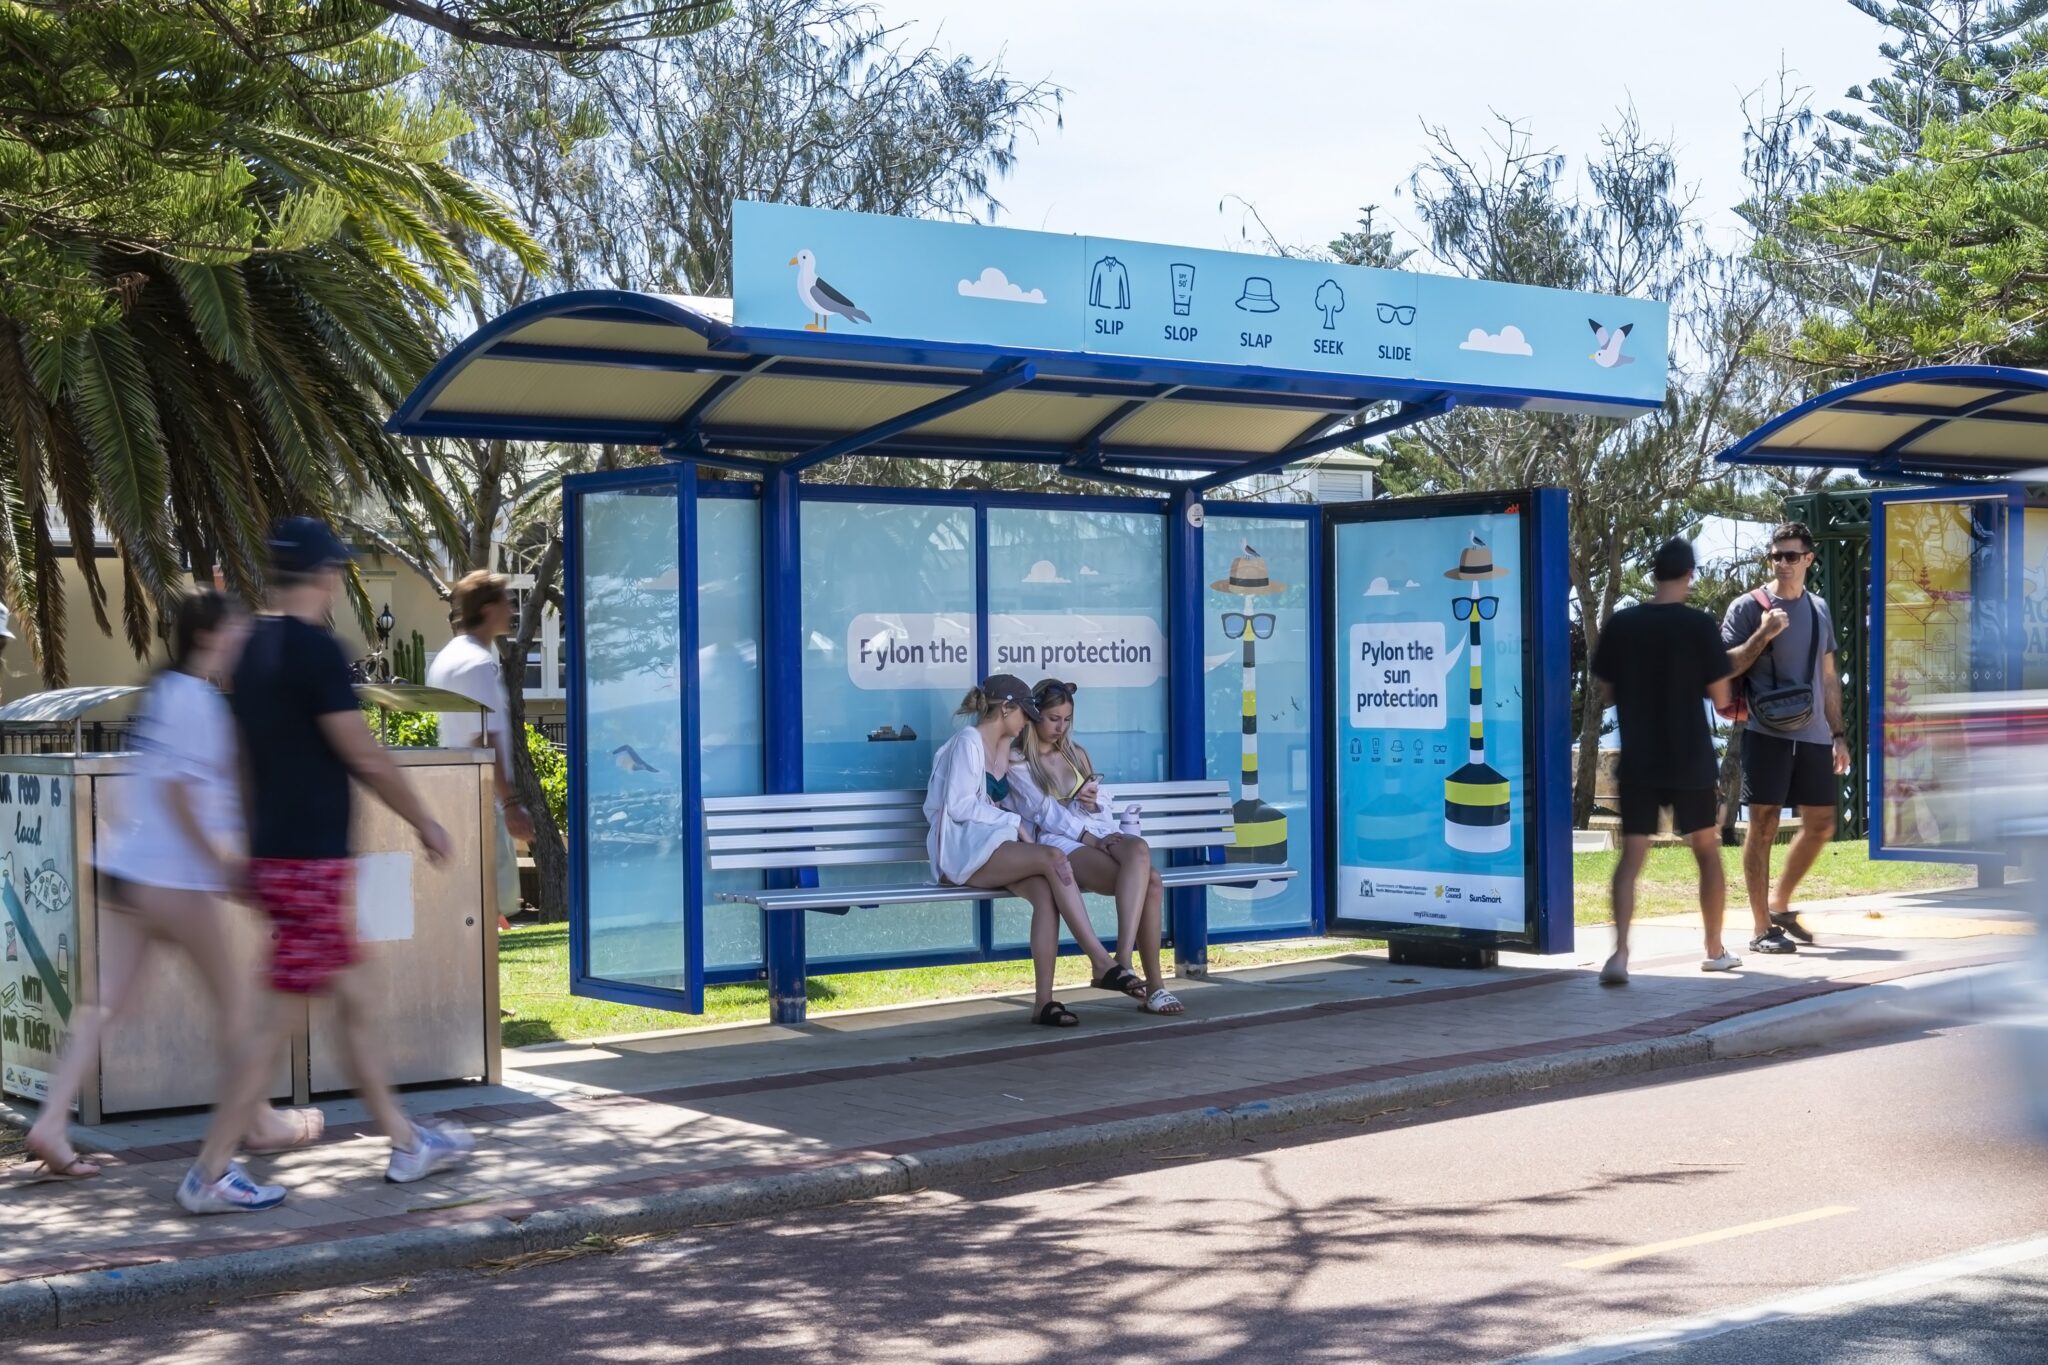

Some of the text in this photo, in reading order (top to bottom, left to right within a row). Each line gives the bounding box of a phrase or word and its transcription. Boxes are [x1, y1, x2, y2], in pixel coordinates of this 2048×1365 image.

[1095, 318, 1124, 336] SLIP
[1164, 325, 1198, 342] SLOP
[1240, 332, 1272, 349] SLAP
[1313, 339, 1344, 355] SEEK
[1378, 345, 1412, 361] SLIDE
[860, 638, 968, 671] Pylon the
[998, 638, 1151, 670] sun protection
[1361, 640, 1434, 667] Pylon the
[1383, 669, 1411, 684] sun
[1357, 687, 1438, 713] protection
[18, 774, 40, 806] FOOD
[51, 777, 61, 807] IS
[14, 810, 42, 846] laced
[1445, 892, 1462, 900] Council
[1469, 893, 1502, 904] SunSmart
[22, 974, 42, 1004] WITH
[3, 1014, 19, 1045] OUR
